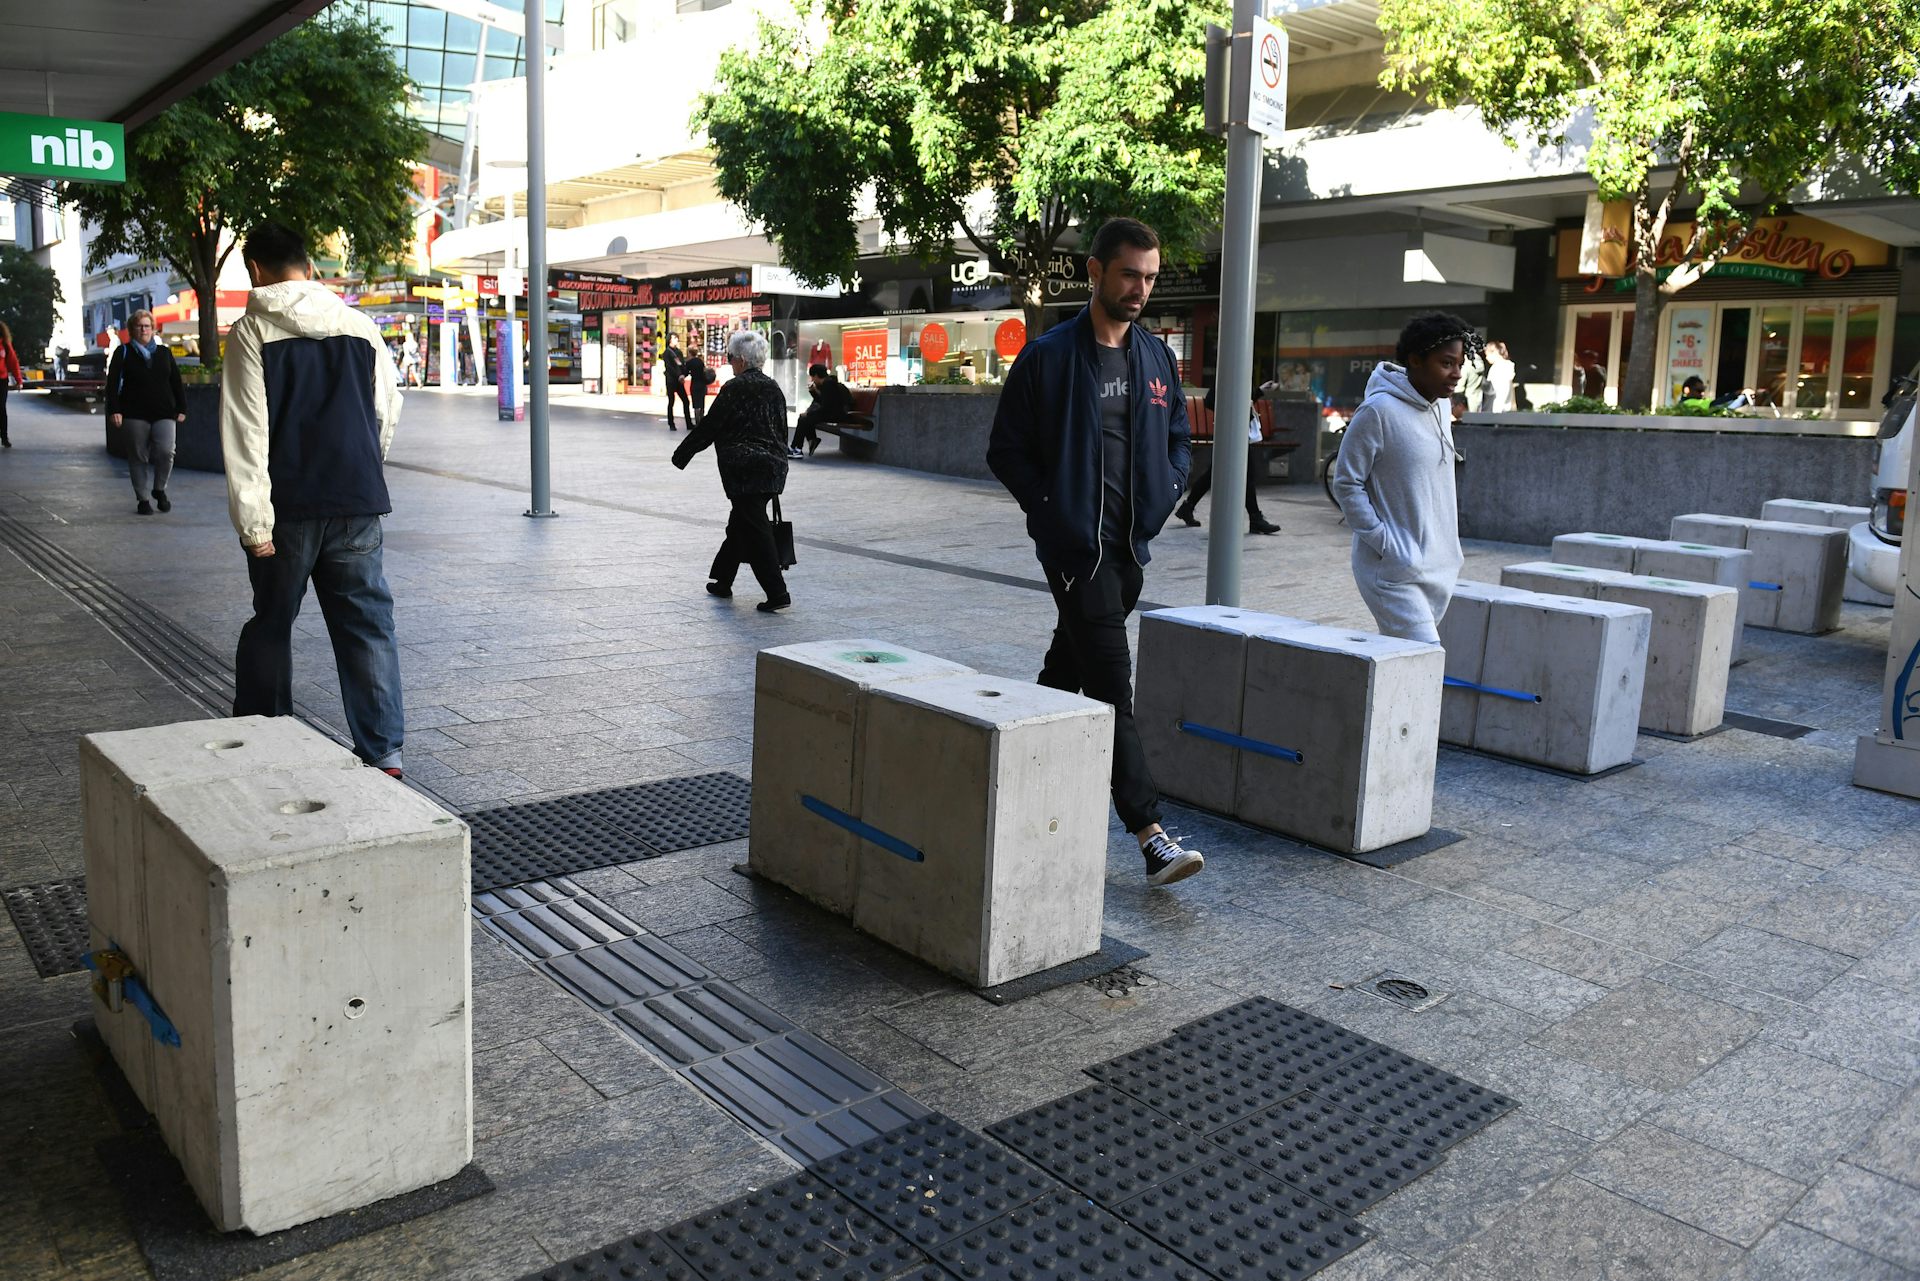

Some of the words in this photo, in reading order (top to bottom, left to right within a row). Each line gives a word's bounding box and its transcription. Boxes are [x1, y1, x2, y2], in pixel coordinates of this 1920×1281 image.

[1262, 94, 1284, 112] SMOKING
[31, 127, 115, 170] nib
[687, 279, 708, 288] Tourist
[709, 277, 729, 286] House
[1752, 267, 1797, 283] ITALIA
[558, 280, 594, 291] DISCOUNT
[595, 282, 633, 294] SOUVENIRS
[659, 289, 705, 305] DISCOUNT
[706, 284, 762, 301] SOUVENI
[923, 332, 945, 344] SALE
[855, 344, 883, 361] SALE
[1100, 376, 1129, 398] urle
